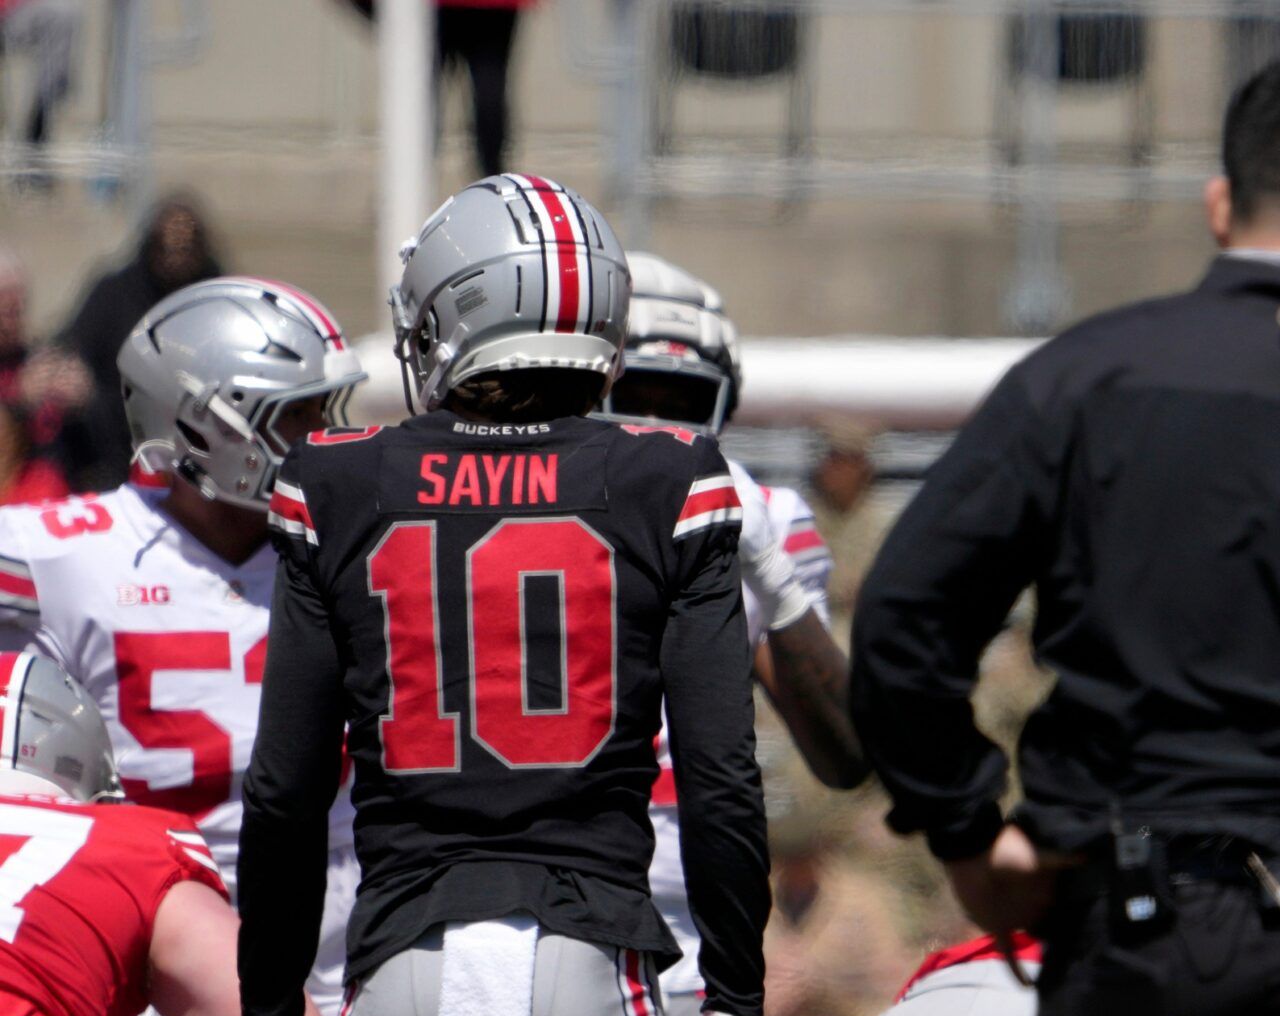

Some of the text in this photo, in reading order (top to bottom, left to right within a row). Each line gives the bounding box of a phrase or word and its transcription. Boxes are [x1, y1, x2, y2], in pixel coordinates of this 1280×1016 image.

[453, 421, 551, 436] BUCKEYES
[416, 453, 559, 506] SAYIN
[366, 515, 618, 776] 10
[20, 744, 38, 759] 67
[113, 630, 269, 824] 5
